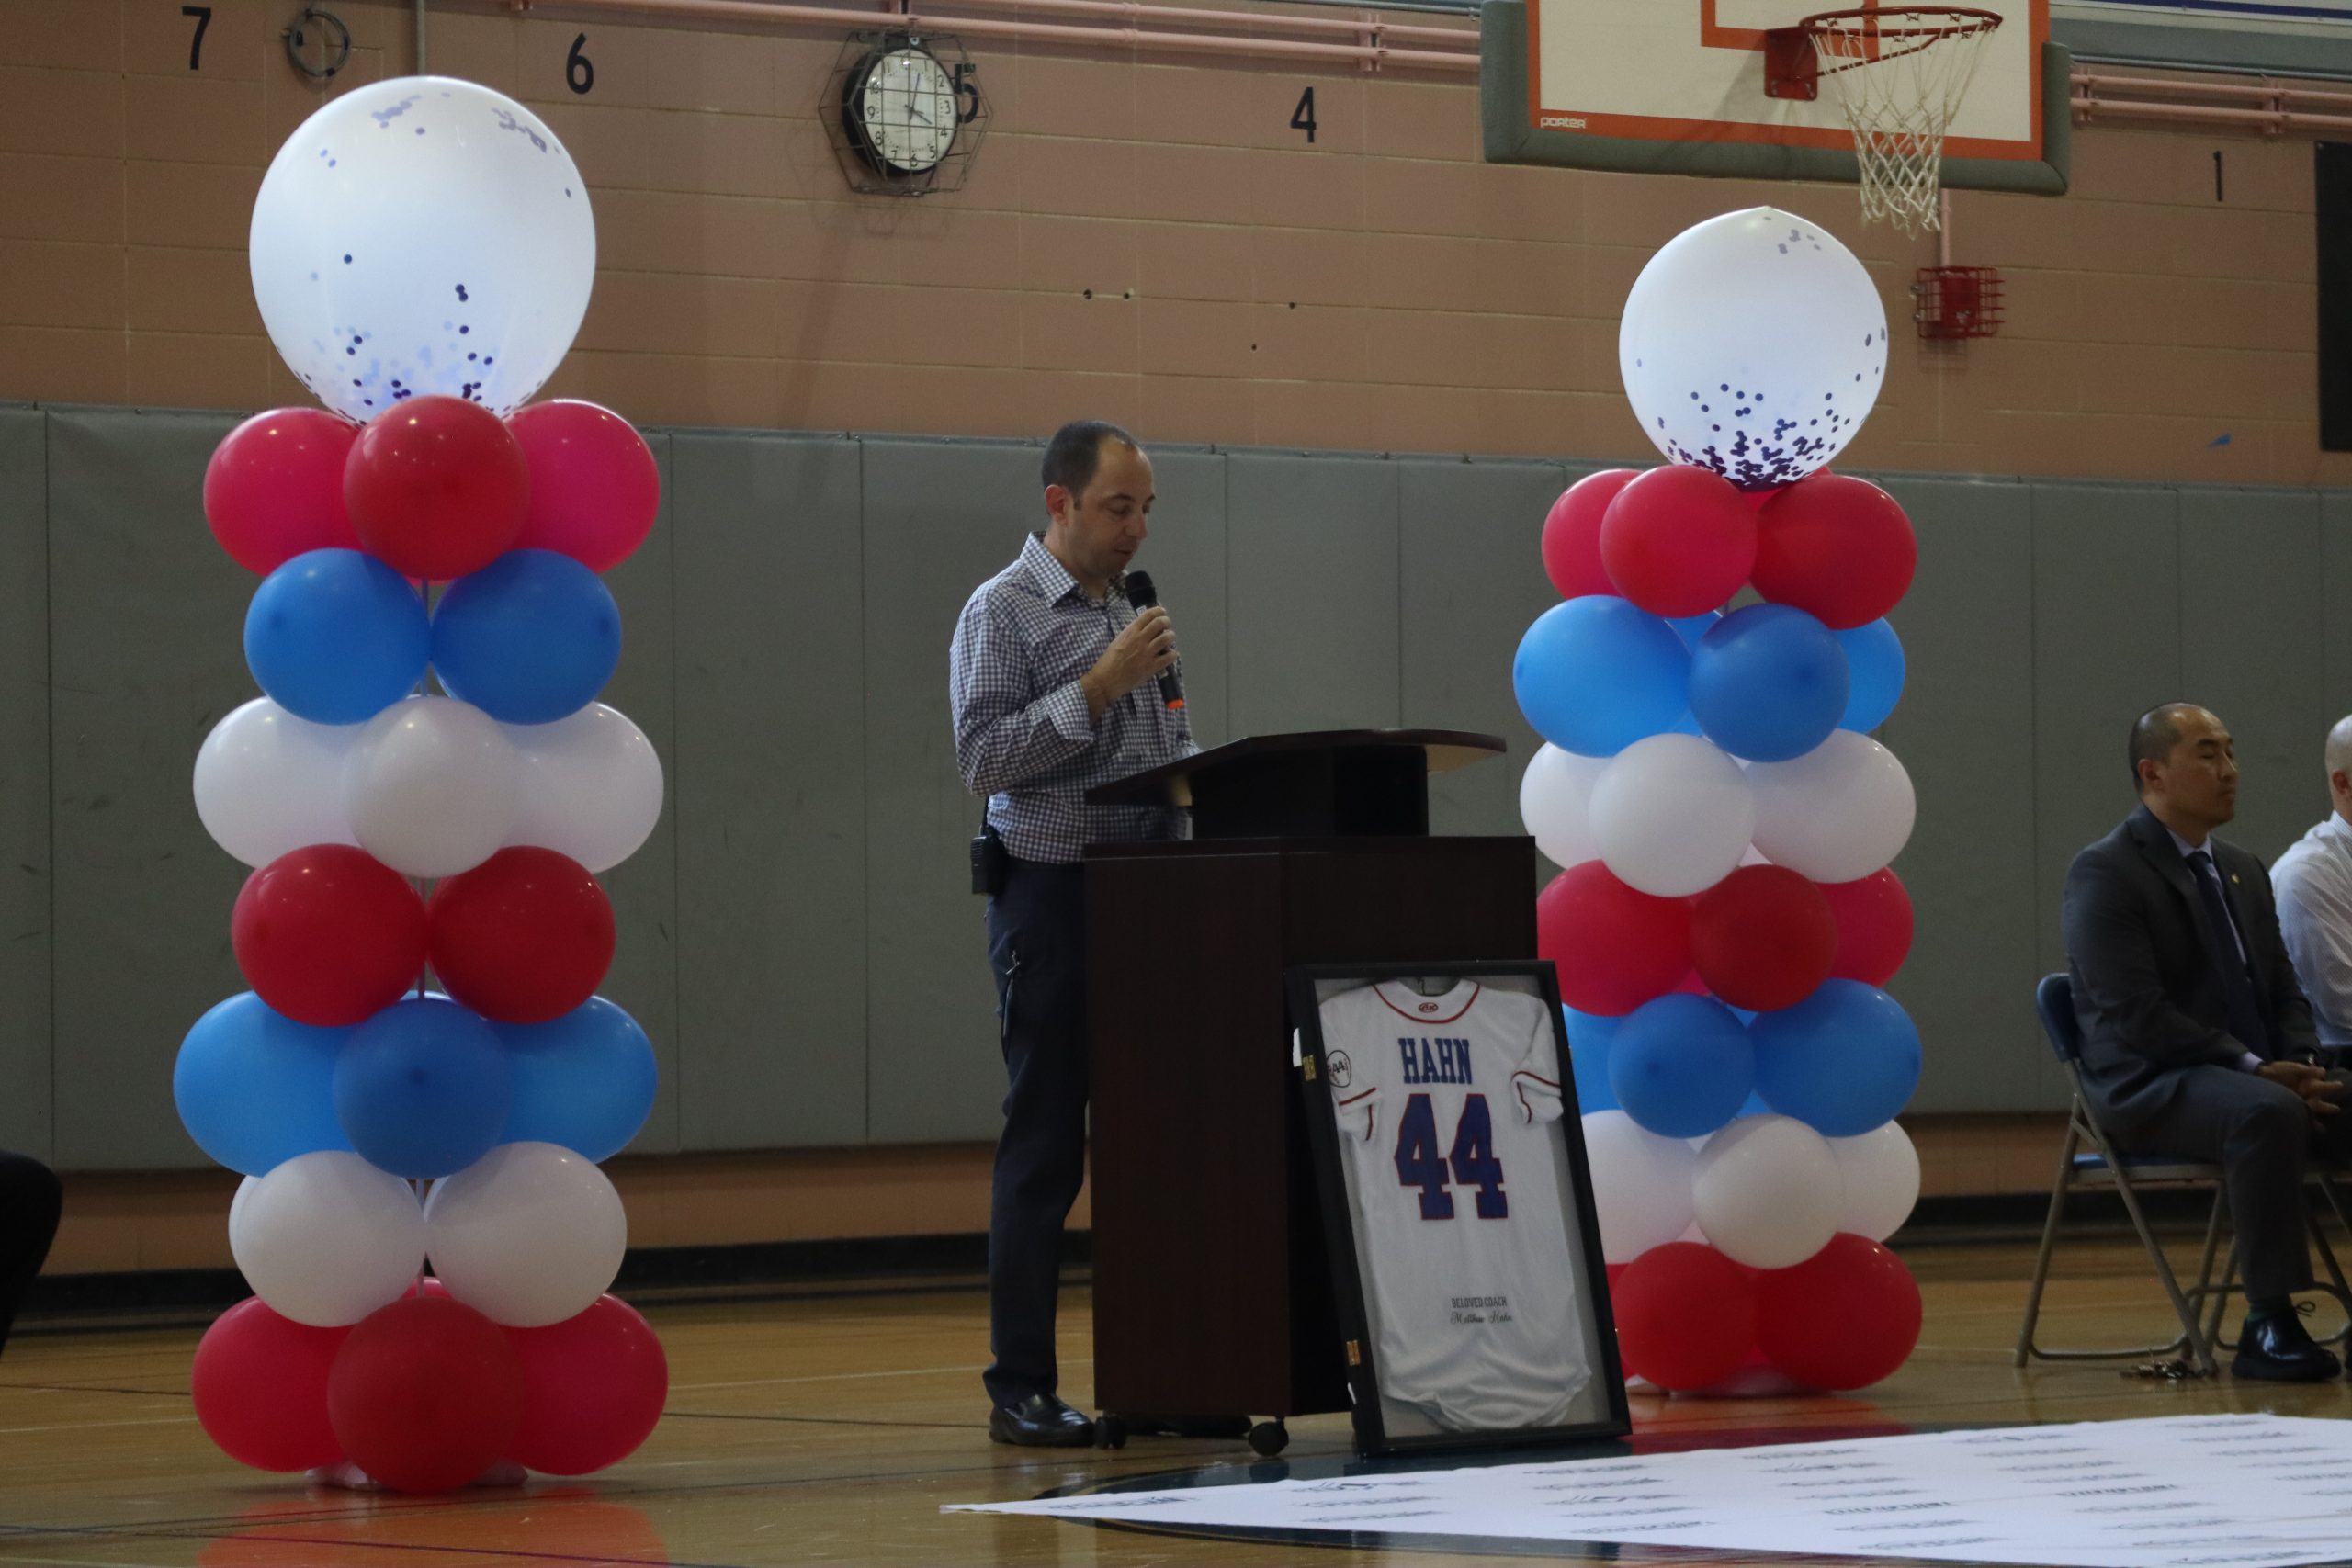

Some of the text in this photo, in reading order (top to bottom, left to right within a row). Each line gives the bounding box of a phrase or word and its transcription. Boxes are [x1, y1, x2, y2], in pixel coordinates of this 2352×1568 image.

[182, 6, 211, 70] 7
[566, 32, 594, 95] 6
[938, 74, 945, 87] 2
[869, 81, 879, 96] 10
[954, 63, 978, 124] 5
[866, 106, 875, 119] 9
[944, 100, 951, 114] 3
[1290, 86, 1317, 143] 4
[875, 131, 883, 147] 8
[940, 125, 948, 138] 4
[890, 150, 898, 163] 7
[910, 153, 919, 167] 6
[929, 146, 935, 159] 5
[2212, 150, 2222, 202] 1
[1397, 1038, 1472, 1085] HAHN
[1393, 1093, 1508, 1220] 44
[1452, 1296, 1507, 1308] BELOVED COACH
